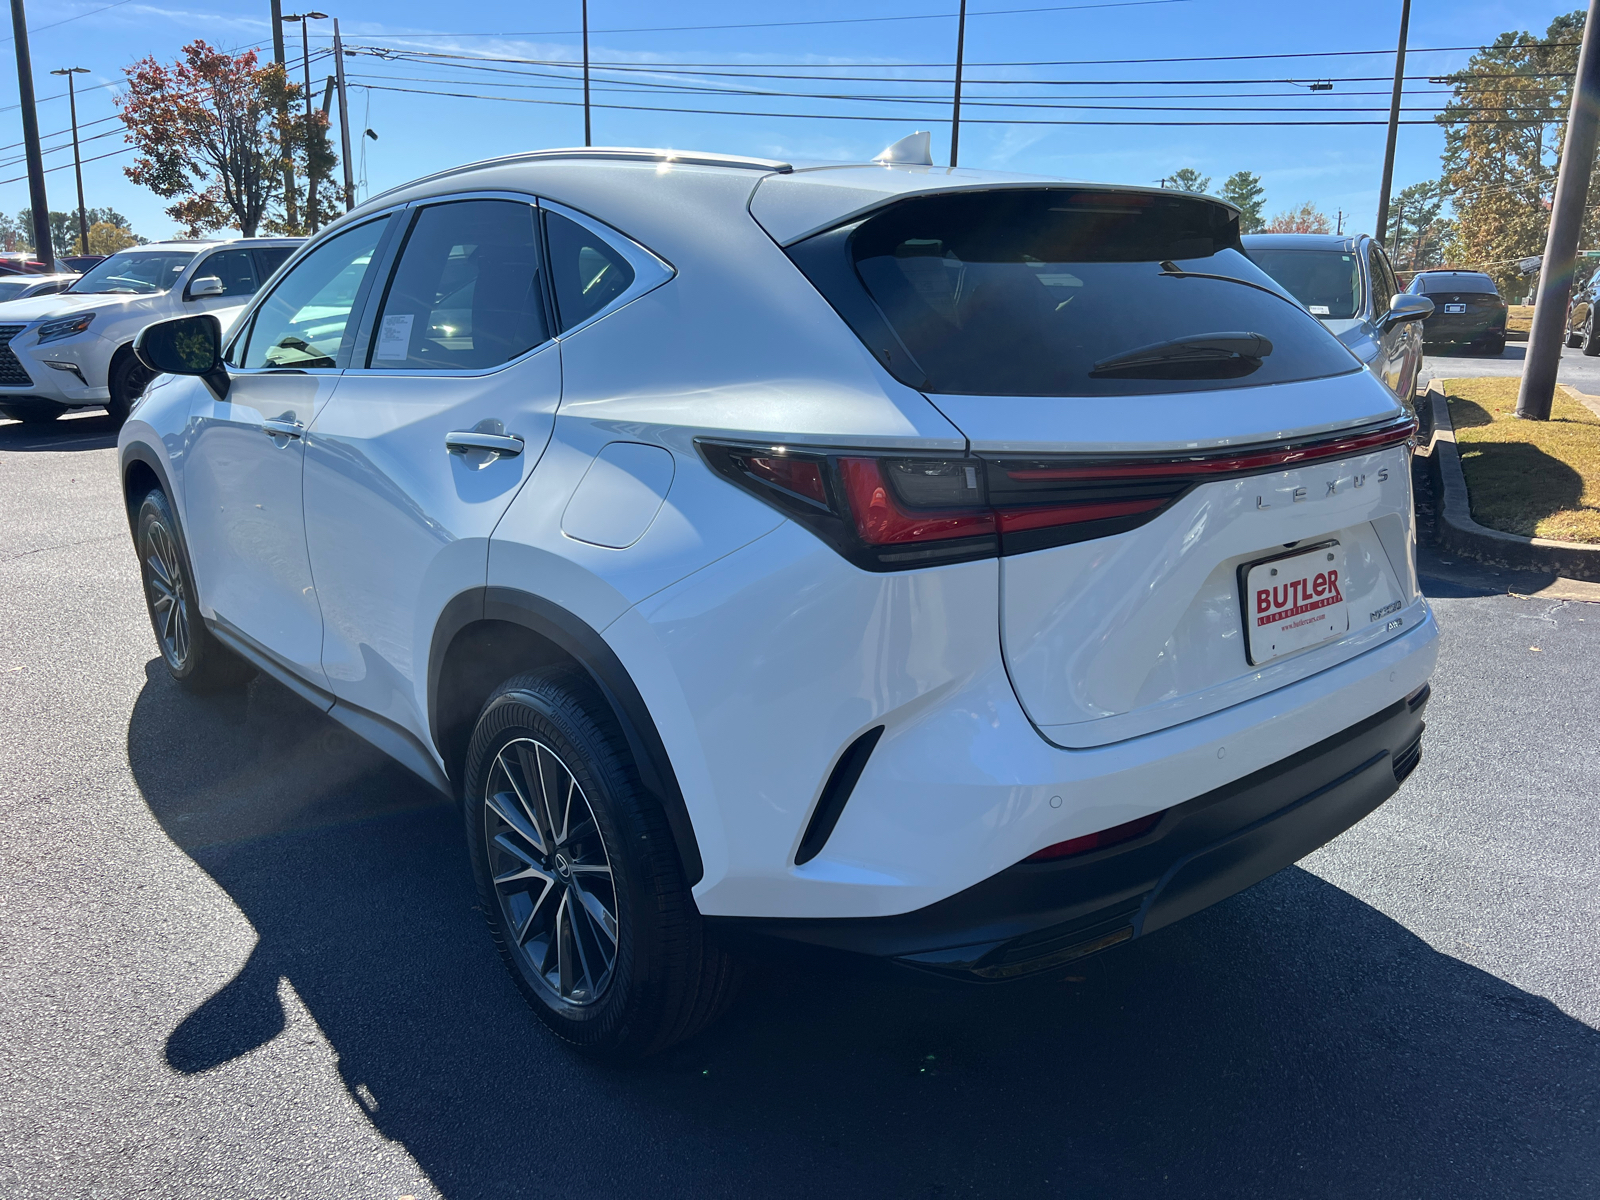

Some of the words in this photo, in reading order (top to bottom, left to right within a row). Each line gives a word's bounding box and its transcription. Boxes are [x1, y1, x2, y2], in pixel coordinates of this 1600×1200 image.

[1256, 468, 1389, 510] LEXUS
[1258, 604, 1311, 626] AUTOMOTIVE
[550, 709, 592, 764] BRIDGESTONE
